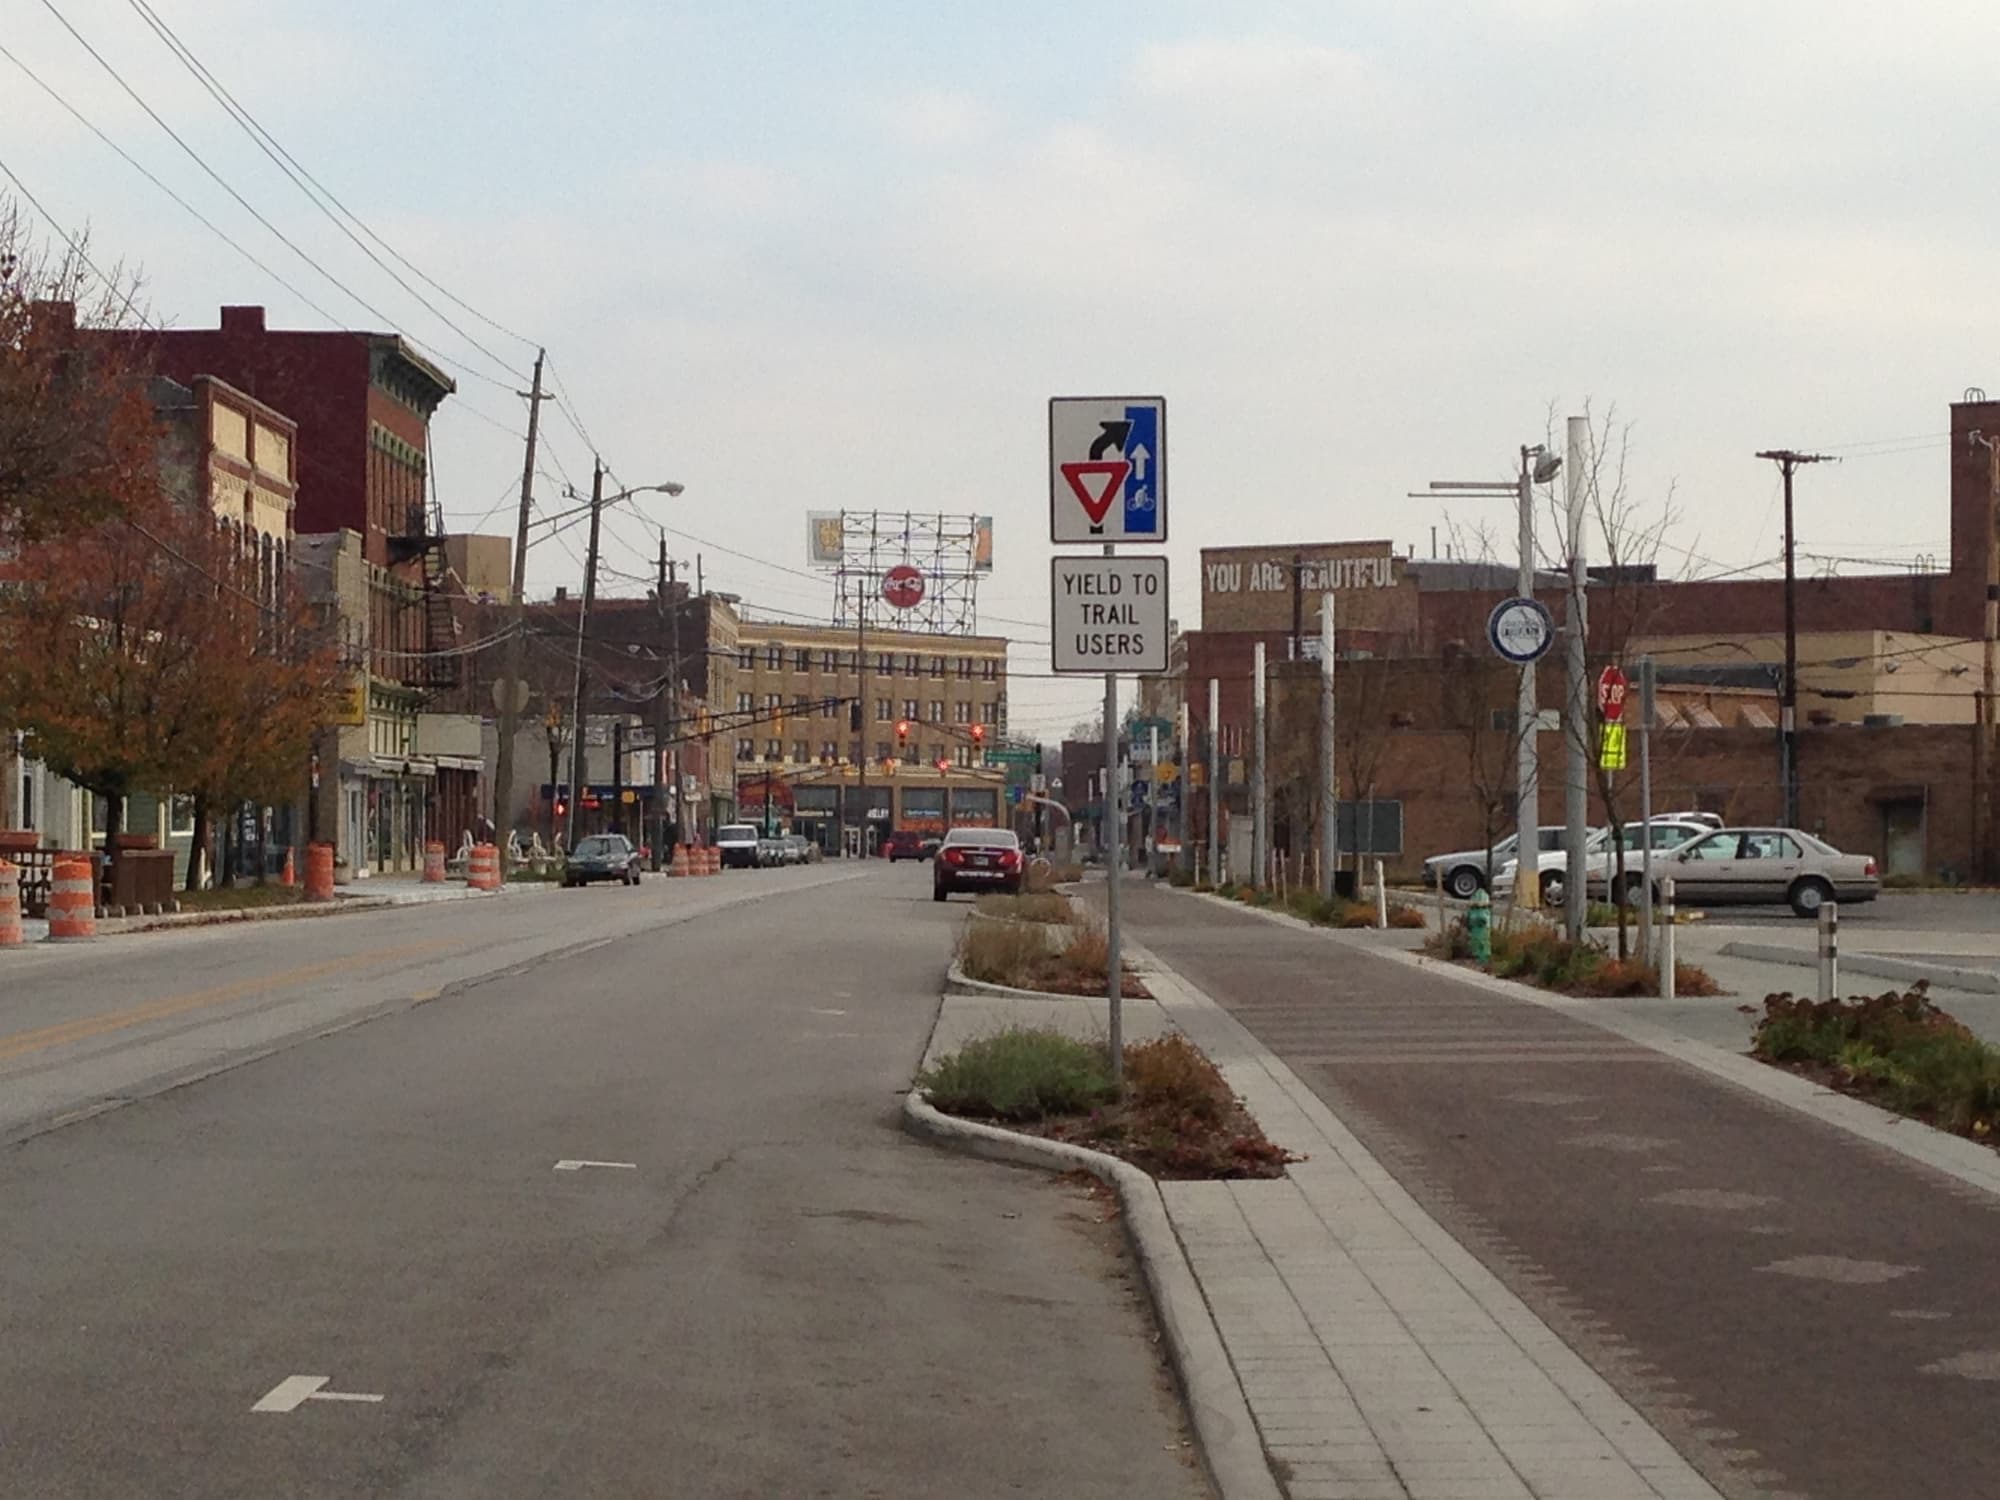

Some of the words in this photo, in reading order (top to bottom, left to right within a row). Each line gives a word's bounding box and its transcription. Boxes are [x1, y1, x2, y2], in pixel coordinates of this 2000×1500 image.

[1063, 573, 1122, 595] YIELD
[1132, 573, 1158, 596] TO
[1207, 562, 1242, 592] YOU
[1250, 560, 1286, 591] ARE
[1081, 603, 1140, 625] TRAIL
[1076, 633, 1144, 655] USERS
[1600, 683, 1625, 704] SOP
